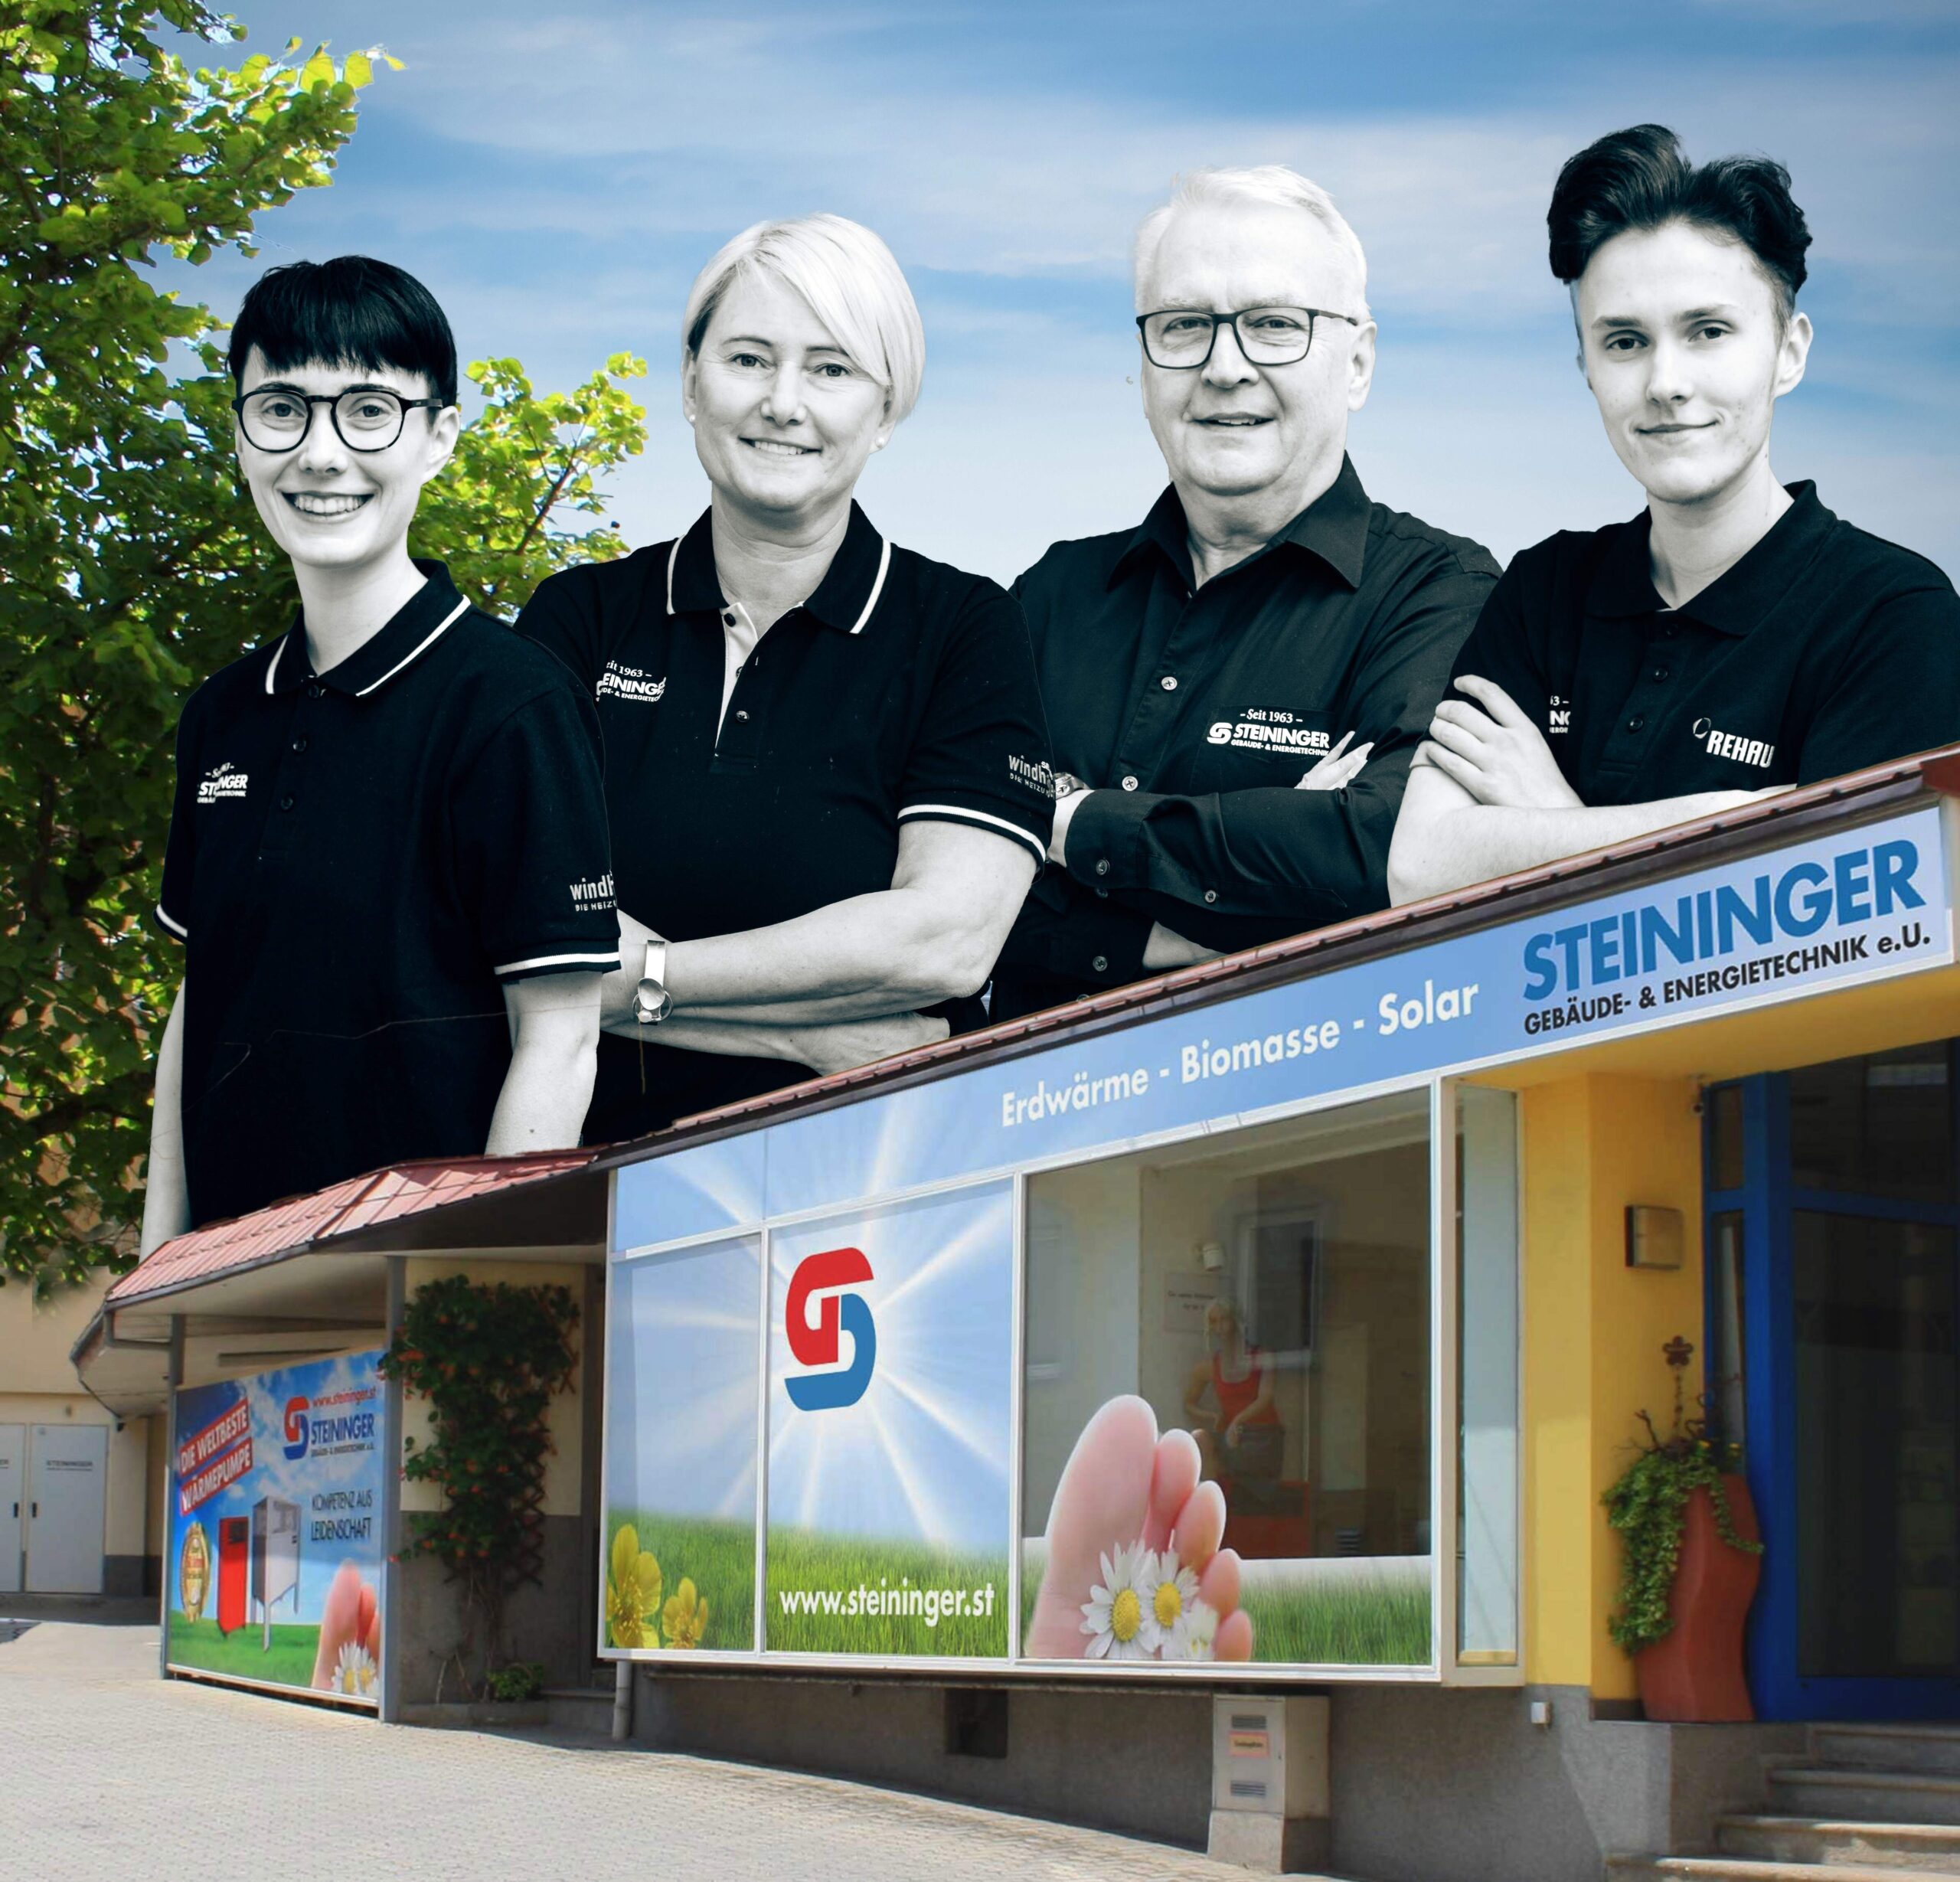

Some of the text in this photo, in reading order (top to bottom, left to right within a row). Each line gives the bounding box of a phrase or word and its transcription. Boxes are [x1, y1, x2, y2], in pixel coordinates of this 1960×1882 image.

[619, 666, 643, 677] 1963
[1269, 711, 1293, 724] 1963
[1233, 724, 1330, 748] STEININGER
[1706, 730, 1775, 768] REHAU
[1010, 773, 1022, 783] DIE
[575, 903, 589, 912] DIE
[1524, 840, 1926, 1001] STEININGER
[1524, 923, 1930, 1035] GEBÄUDE- & ENERGIETECHNIK e.U.
[1002, 1067, 1148, 1127] Erdwärme
[1181, 1019, 1341, 1084] Biomasse
[1378, 980, 1478, 1036] Solar
[181, 1405, 247, 1473] DIE WELTBESTE
[311, 1413, 374, 1445] STEININGER
[779, 1577, 995, 1627] www.steininger.st
